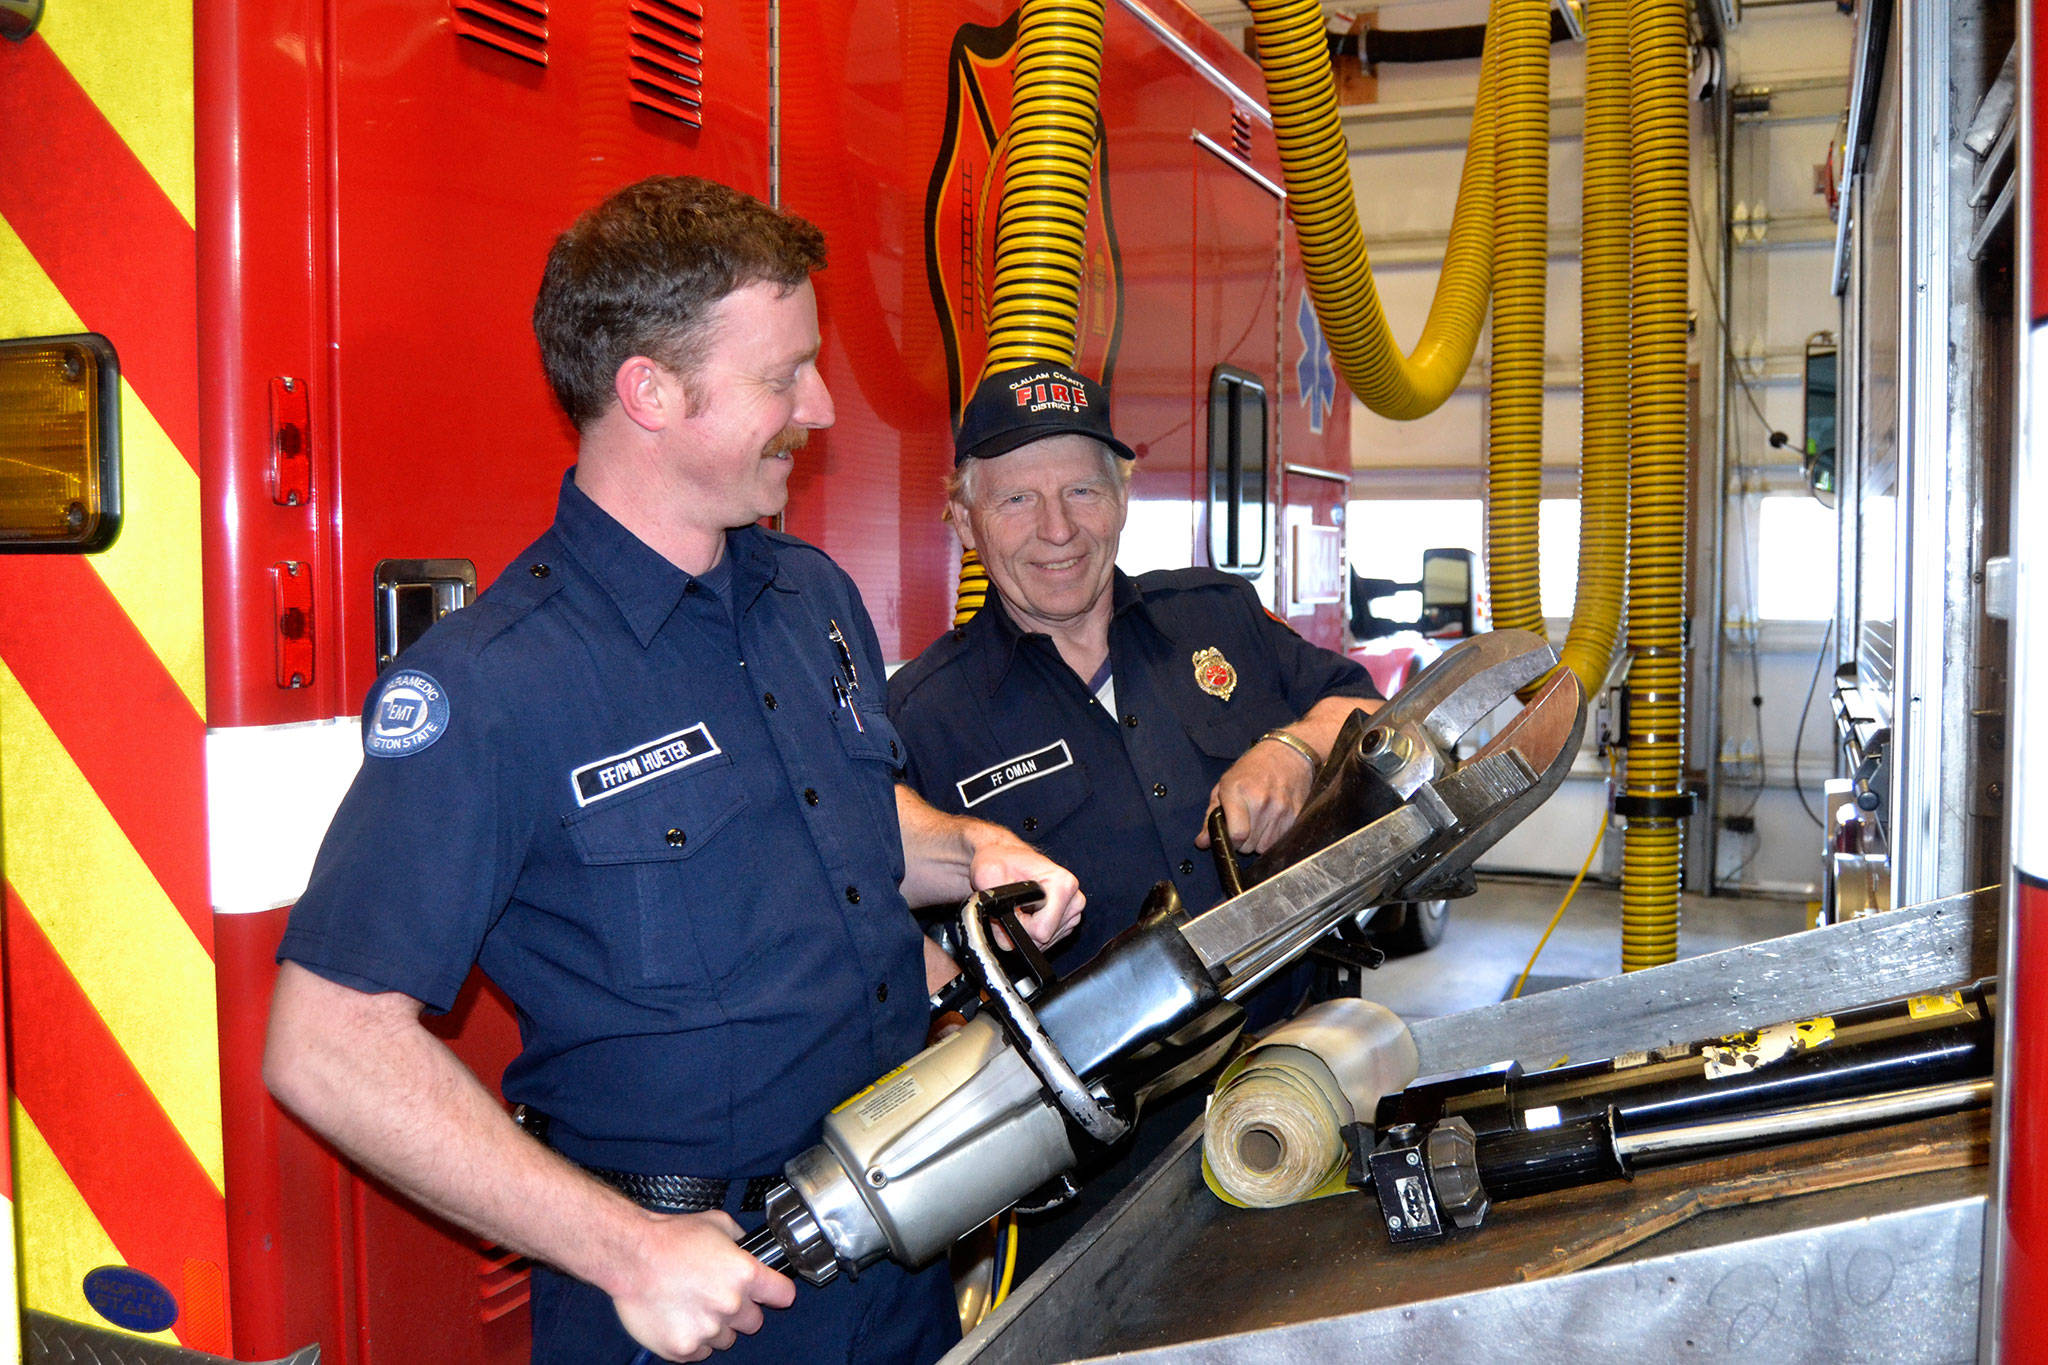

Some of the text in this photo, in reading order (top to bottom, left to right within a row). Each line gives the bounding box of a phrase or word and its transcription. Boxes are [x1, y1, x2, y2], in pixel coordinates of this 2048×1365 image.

[1008, 371, 1085, 390] CLALLAM COUNTY
[1015, 383, 1089, 407] FIRE
[1030, 401, 1080, 413] DISTRICT 3
[388, 704, 415, 721] EMT
[402, 721, 439, 748] STATE
[598, 740, 692, 789] FF/PM HUETER
[990, 759, 1038, 787] FF OMAN
